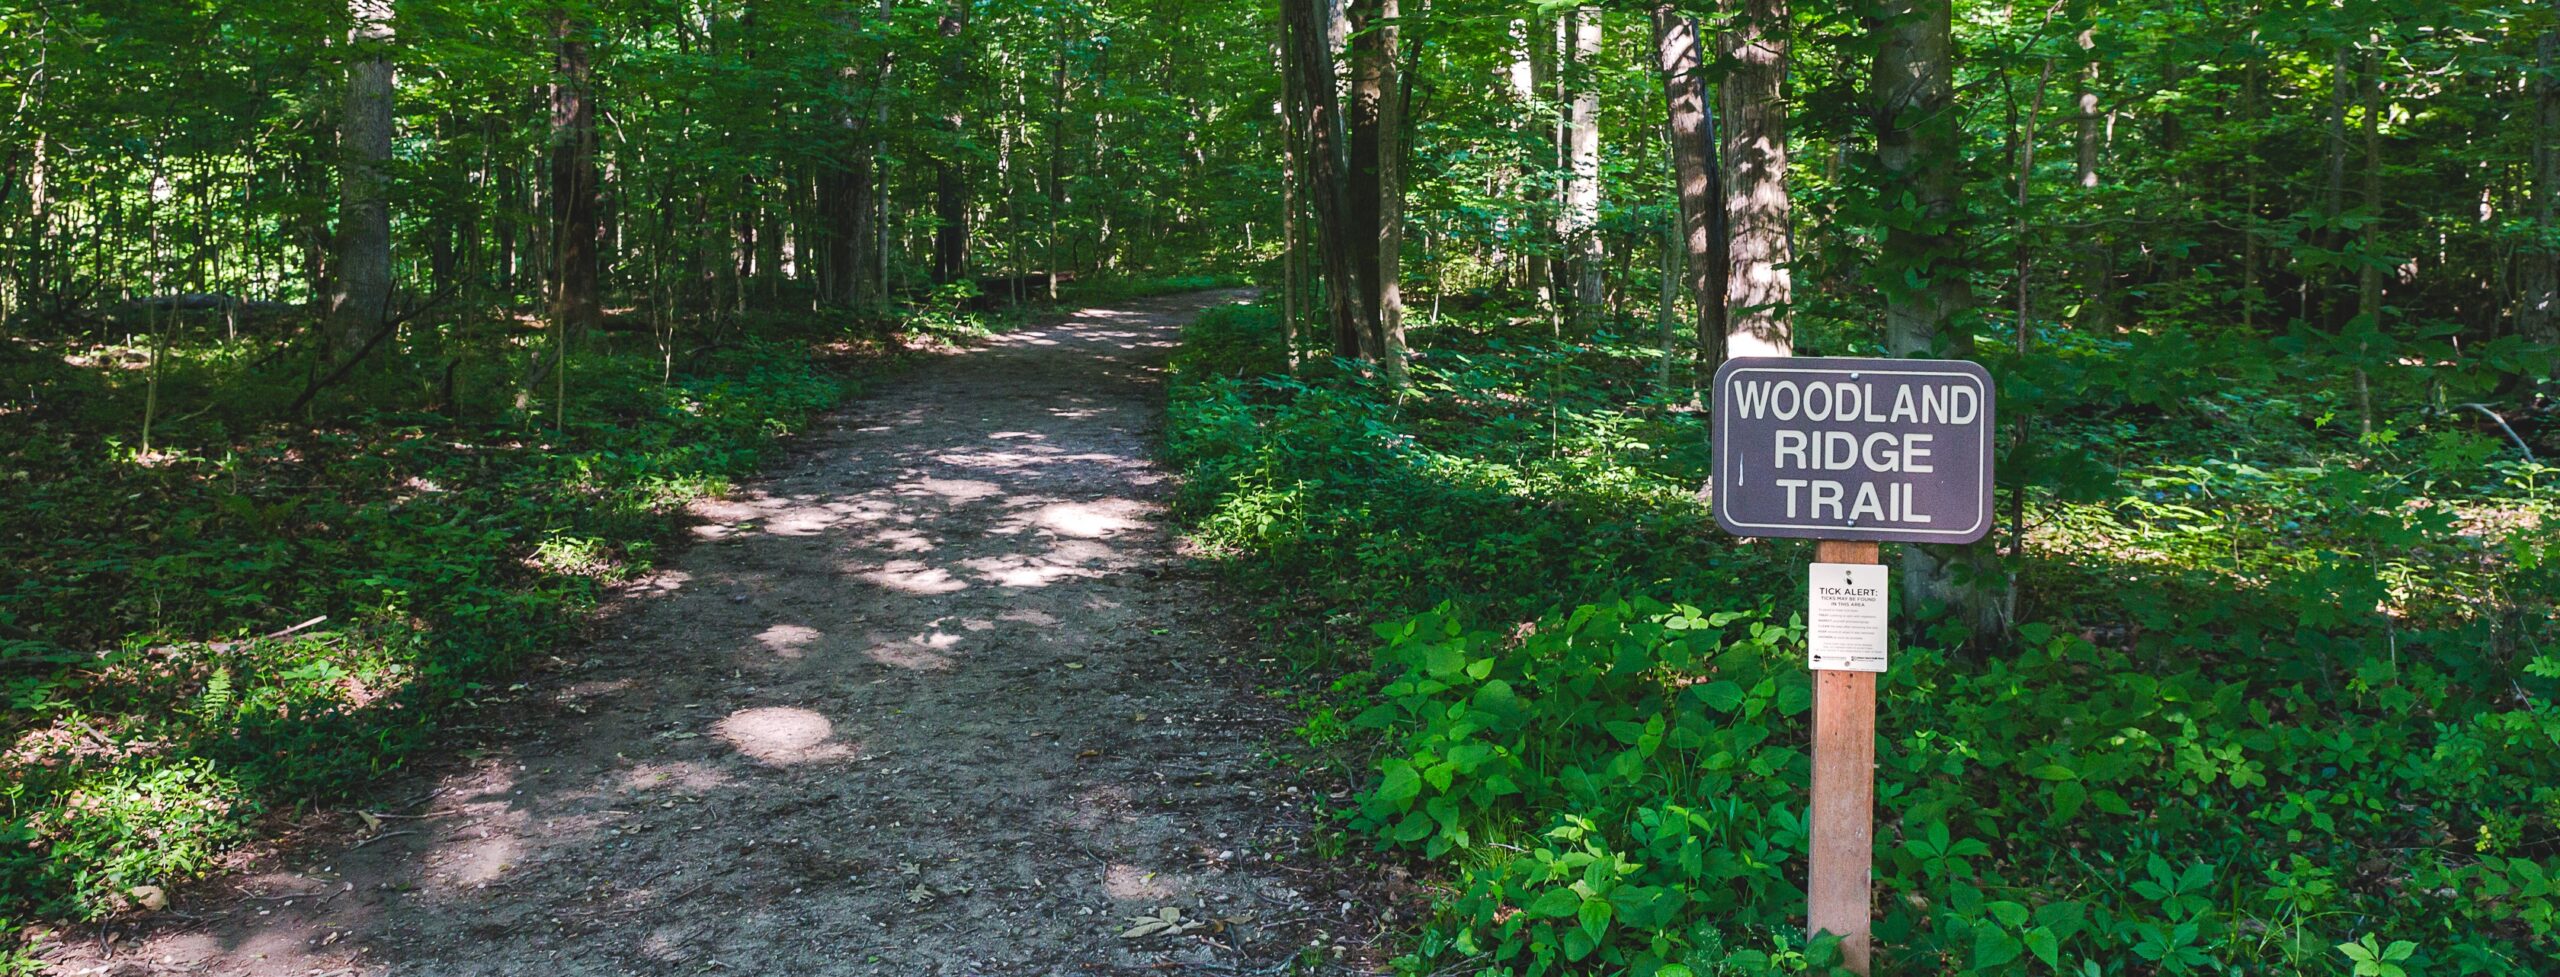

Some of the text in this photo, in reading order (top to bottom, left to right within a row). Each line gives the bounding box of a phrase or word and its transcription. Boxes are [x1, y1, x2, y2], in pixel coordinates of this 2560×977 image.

[1733, 380, 1978, 425] WOODLAND
[1774, 430, 1934, 473] RIDGE
[1775, 479, 1932, 523] TRAIL
[1820, 587, 1878, 597] TICK ALERT:
